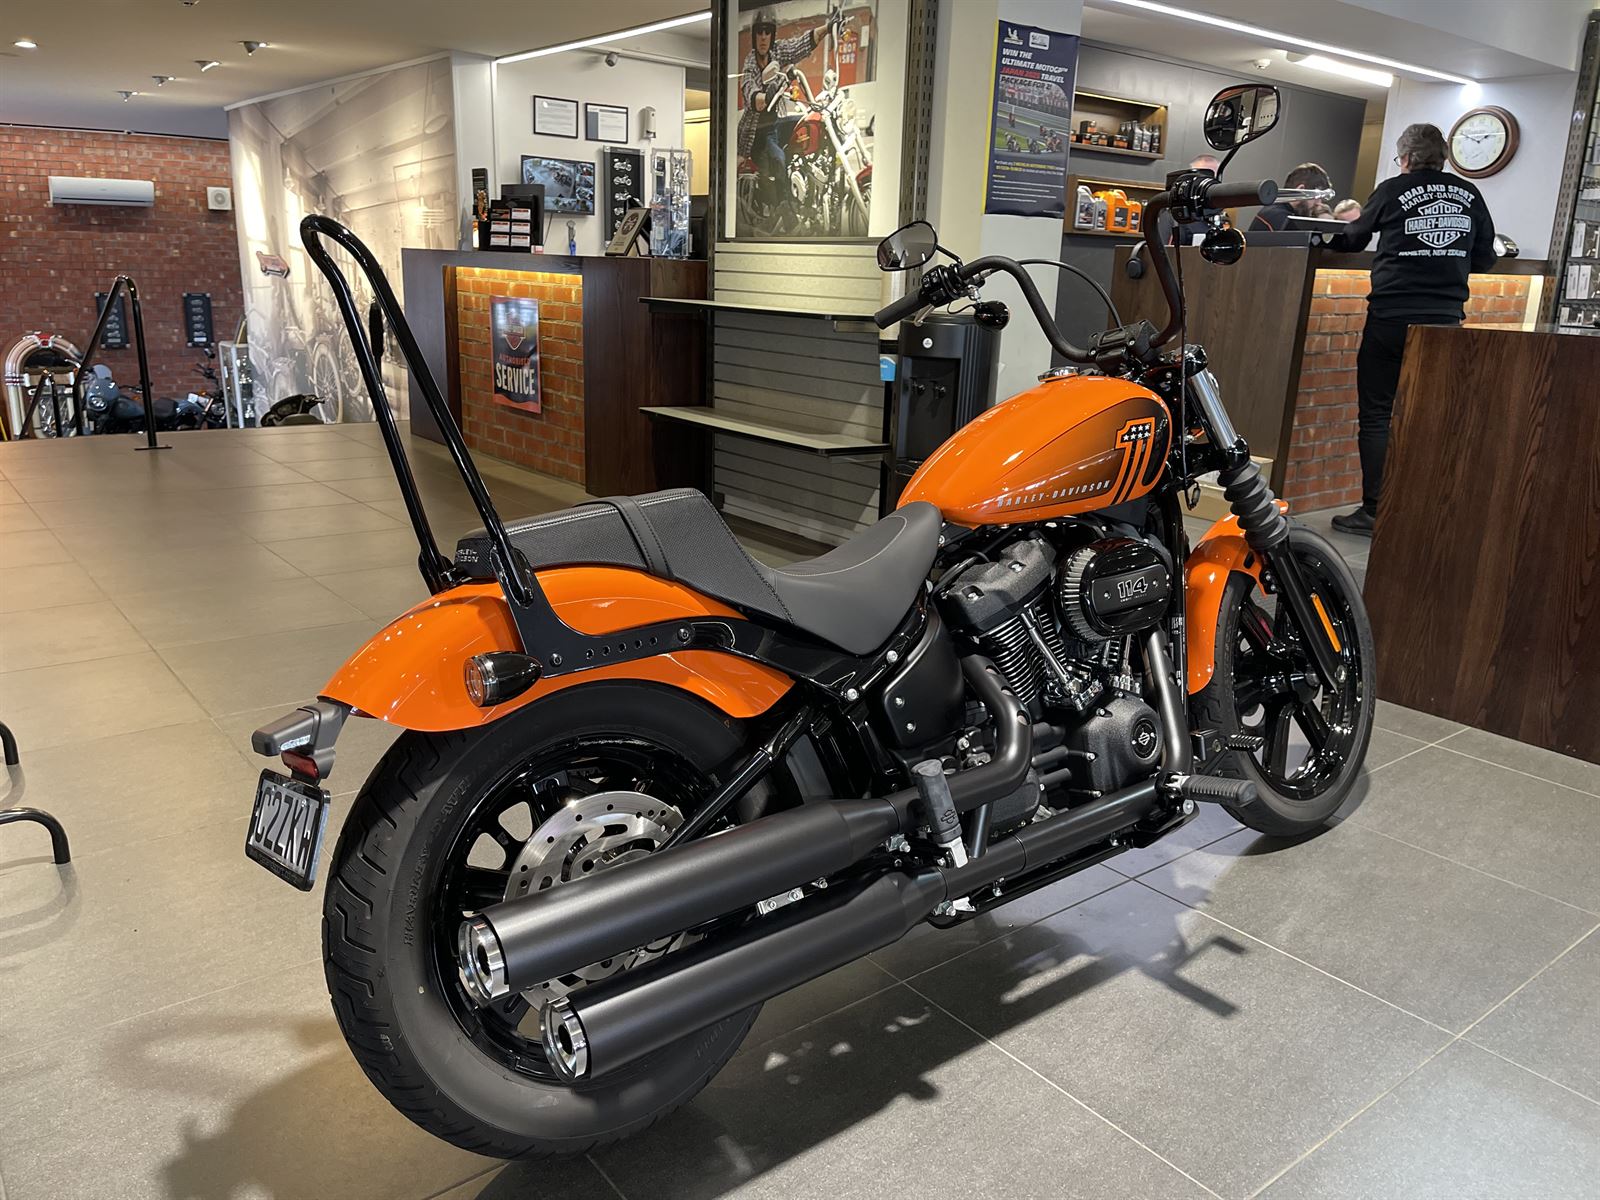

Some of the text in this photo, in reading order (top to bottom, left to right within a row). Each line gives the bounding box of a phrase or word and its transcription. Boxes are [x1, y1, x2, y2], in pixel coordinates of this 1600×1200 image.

[1002, 48, 1033, 60] WIN THE
[1001, 57, 1035, 70] ULTIMATE
[1001, 76, 1032, 87] PACKAGE
[1040, 73, 1065, 83] TRAVEL
[1398, 184, 1476, 205] ROAD AND SPORT
[1424, 204, 1461, 216] MOTOR
[1408, 216, 1470, 232] HARLEY-DAVIDSON
[1422, 231, 1458, 246] CYCLES
[495, 361, 536, 396] SERVICE
[997, 479, 1112, 508] HARLEY-DAVIDSON
[1117, 576, 1149, 599] 114
